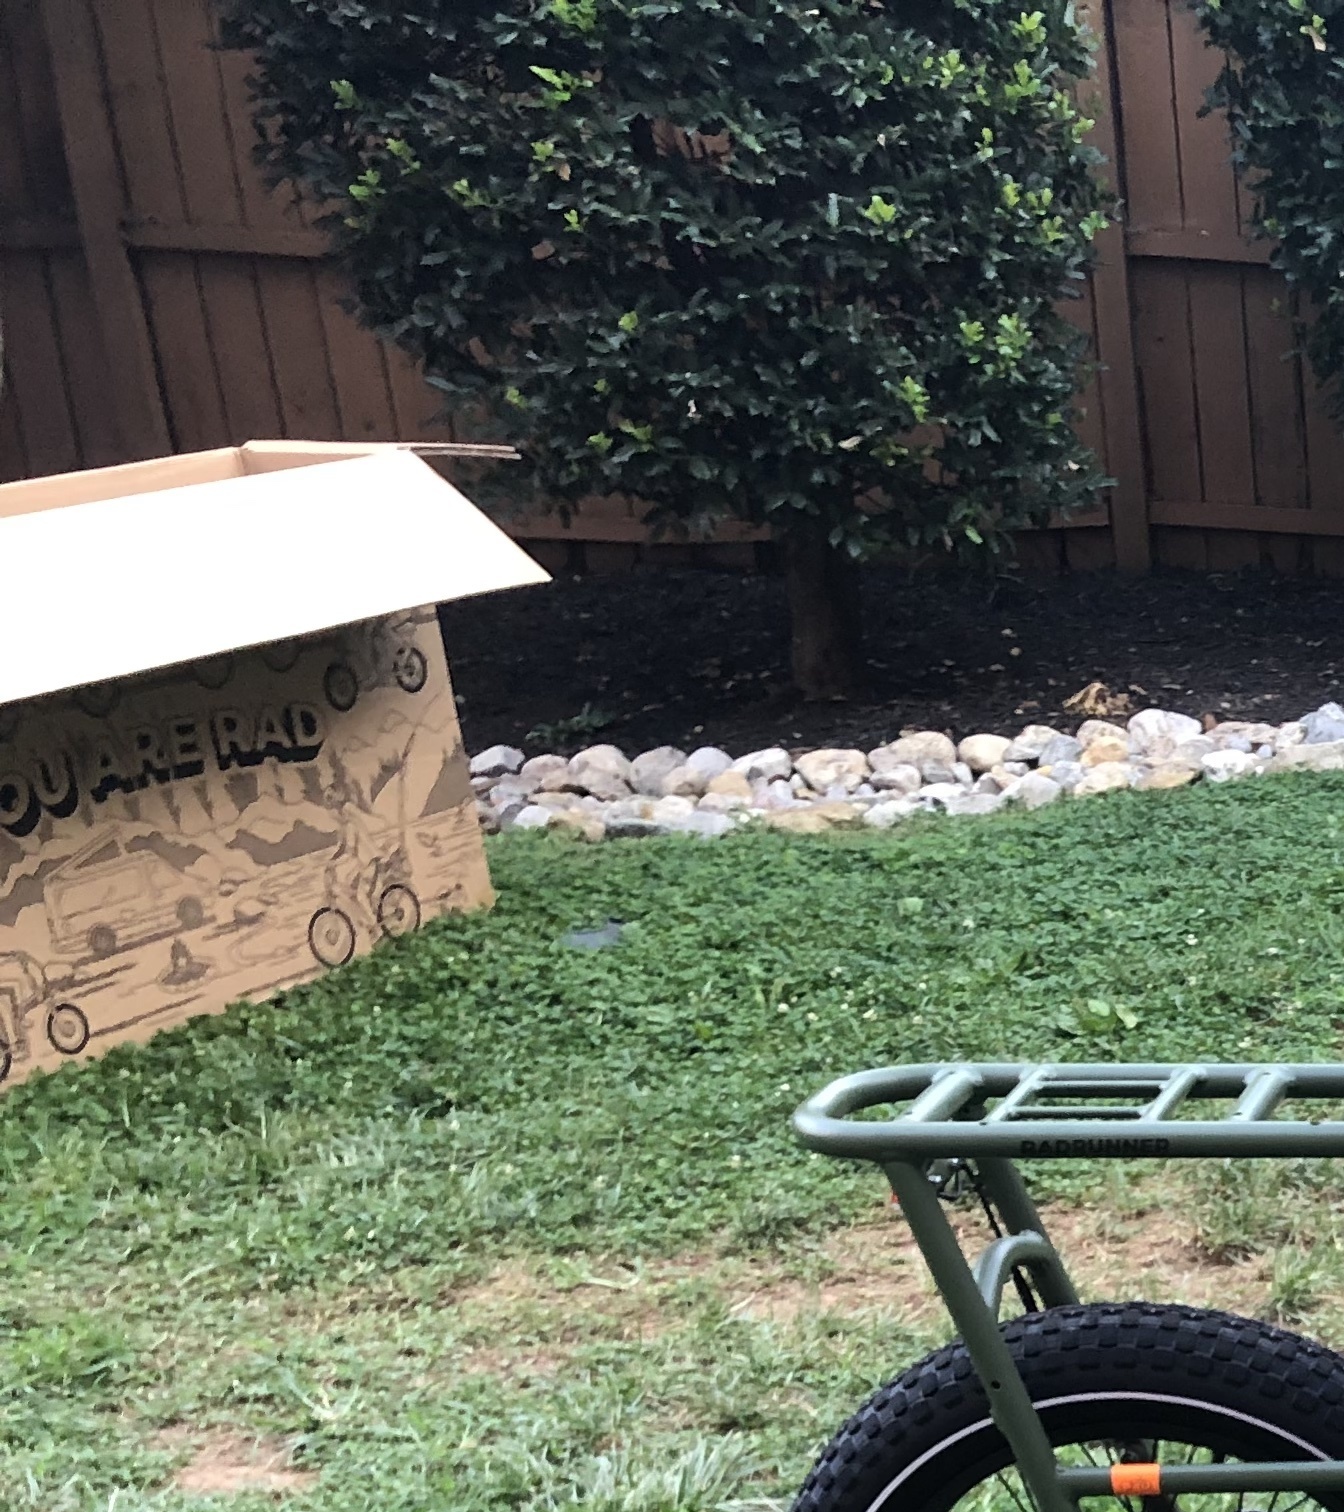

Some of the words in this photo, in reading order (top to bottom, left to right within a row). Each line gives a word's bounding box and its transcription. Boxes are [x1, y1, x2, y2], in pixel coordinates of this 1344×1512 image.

[90, 714, 205, 803] ARE
[210, 702, 326, 771] RAD
[1020, 1137, 1170, 1155] RADRUNNER
